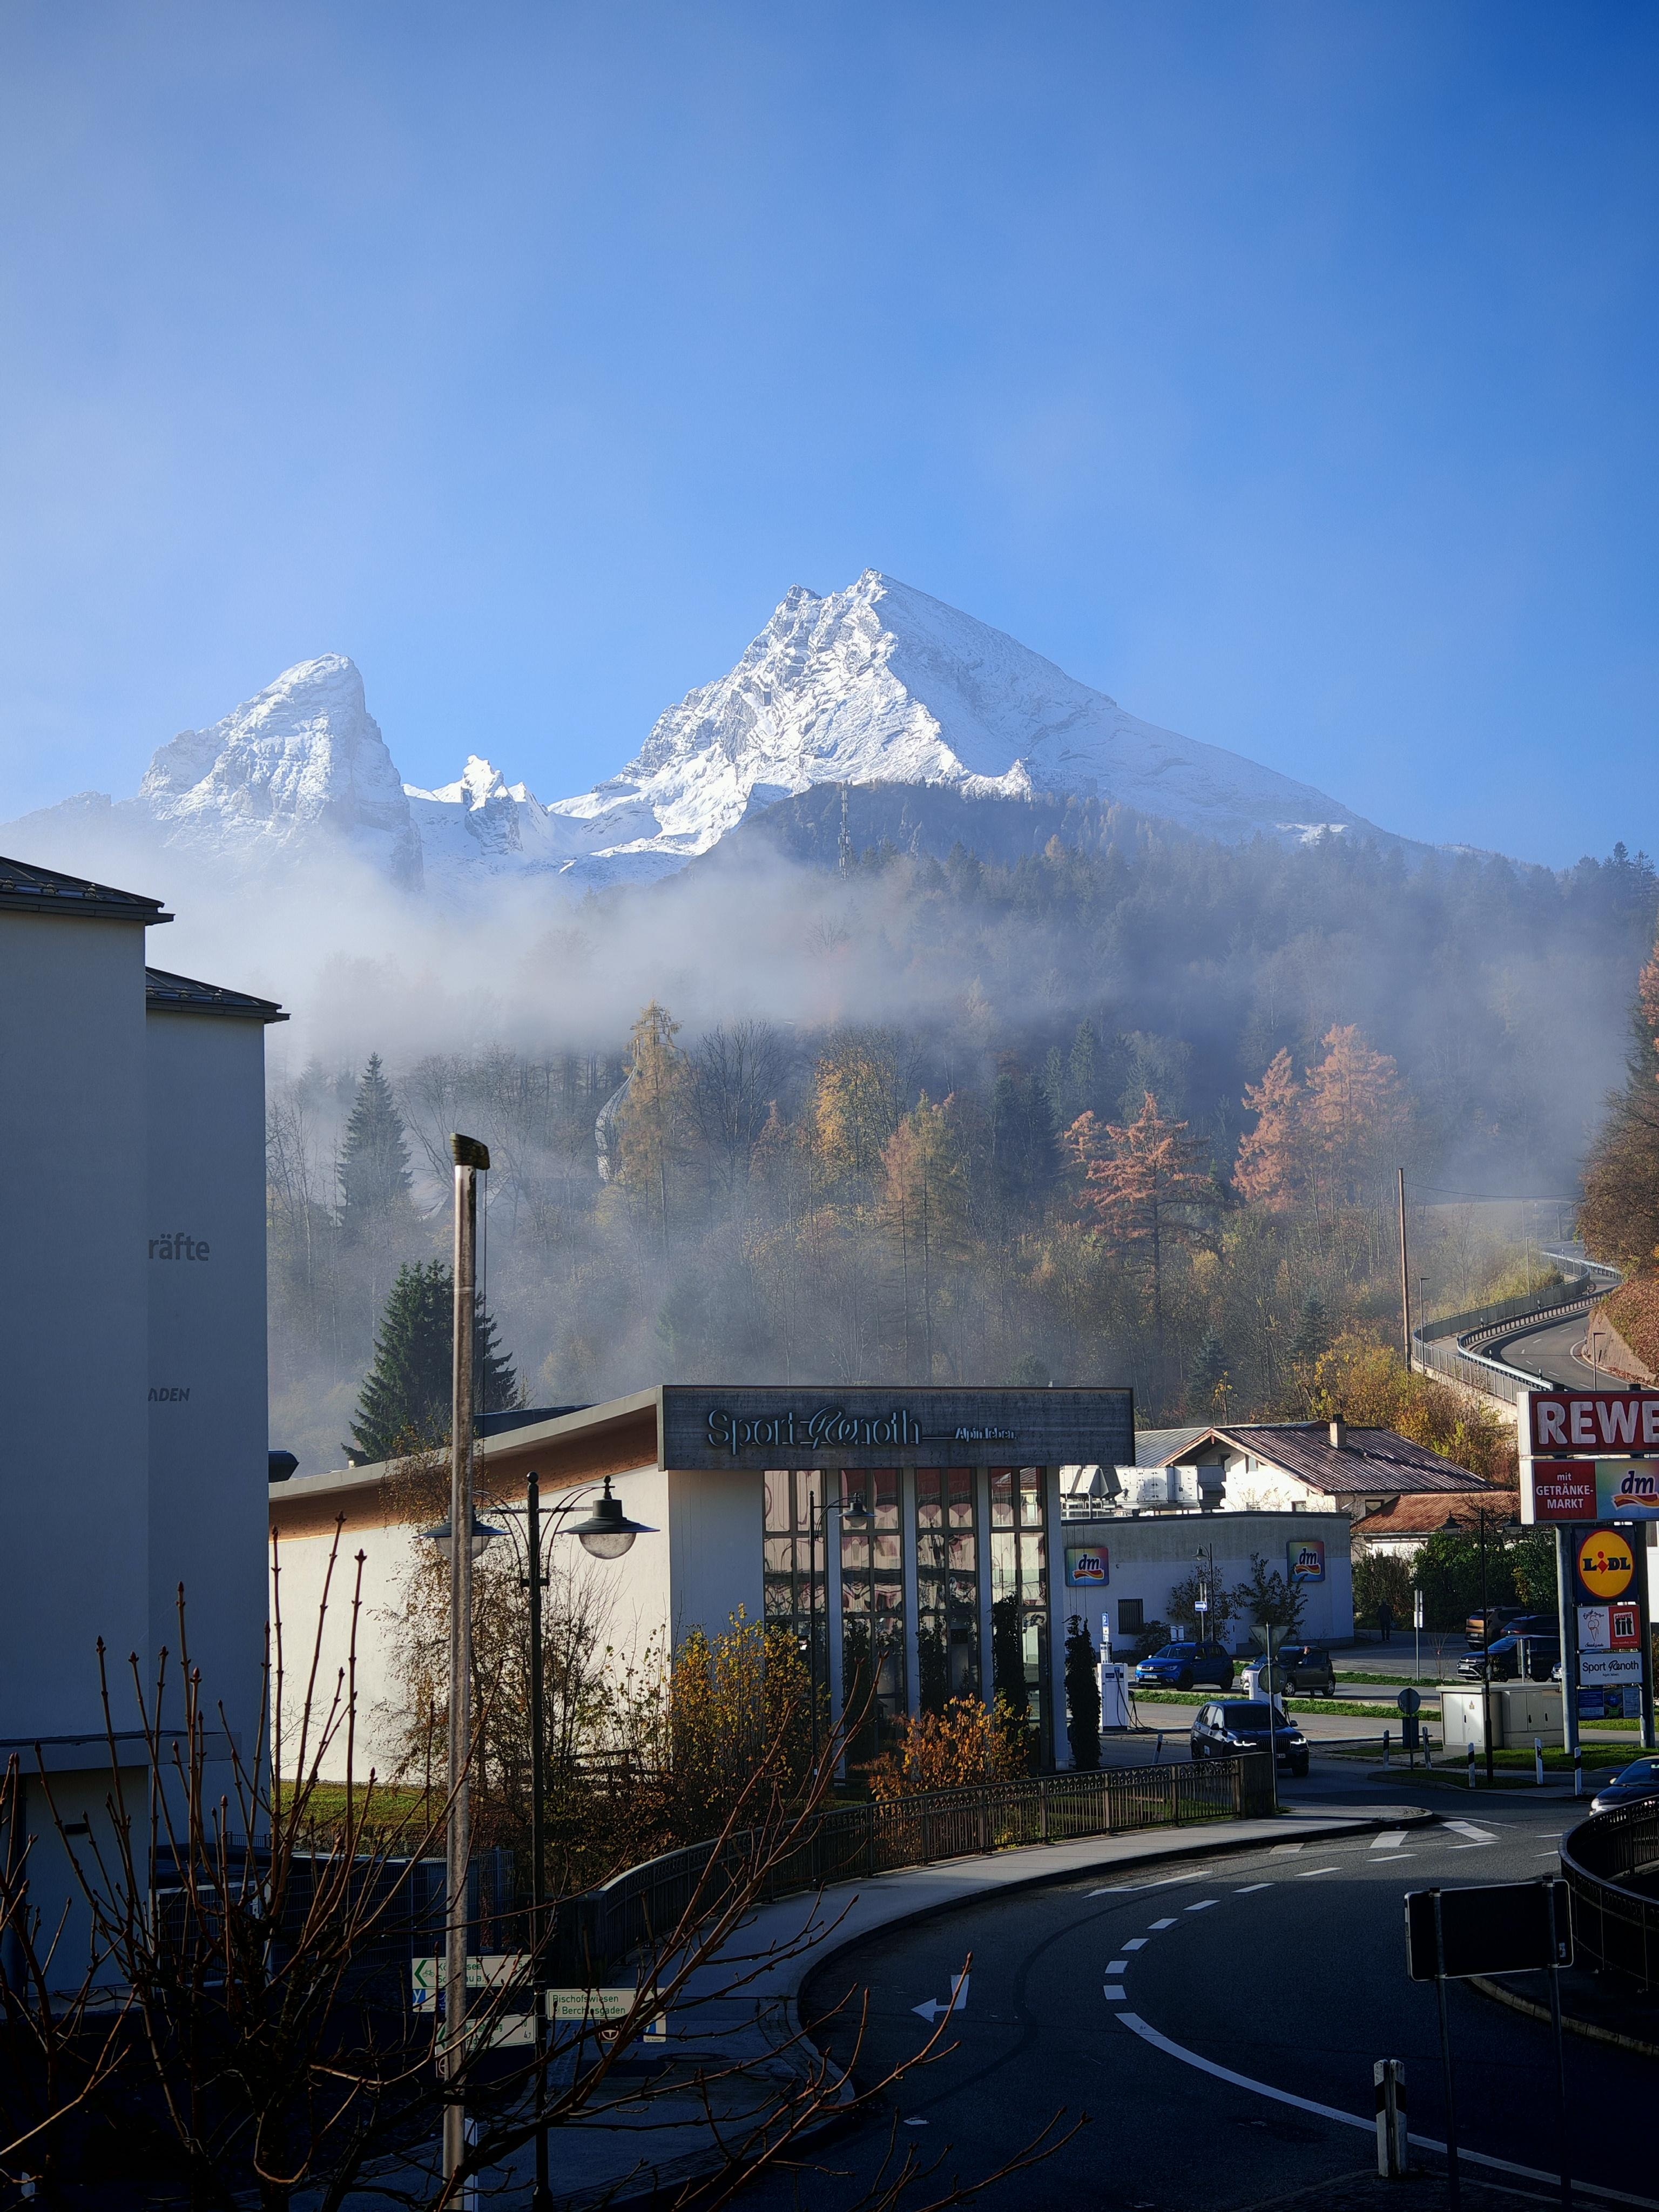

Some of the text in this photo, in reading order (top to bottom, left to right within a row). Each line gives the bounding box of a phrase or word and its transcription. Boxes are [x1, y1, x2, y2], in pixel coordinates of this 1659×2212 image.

[149, 1232, 210, 1262] räfte
[148, 1387, 190, 1402] ADEN
[707, 1405, 922, 1455] Sport Renoth
[1536, 1400, 1659, 1446] REWE
[1556, 1472, 1572, 1482] mit
[1621, 1470, 1655, 1495] dm
[1535, 1482, 1594, 1496] GETRÄNKE-
[1547, 1498, 1584, 1510] MARKT
[1077, 1554, 1101, 1572] dm
[1297, 1547, 1318, 1566] dm
[1615, 1617, 1633, 1635] fit
[1582, 1660, 1640, 1674] Sport Renoth
